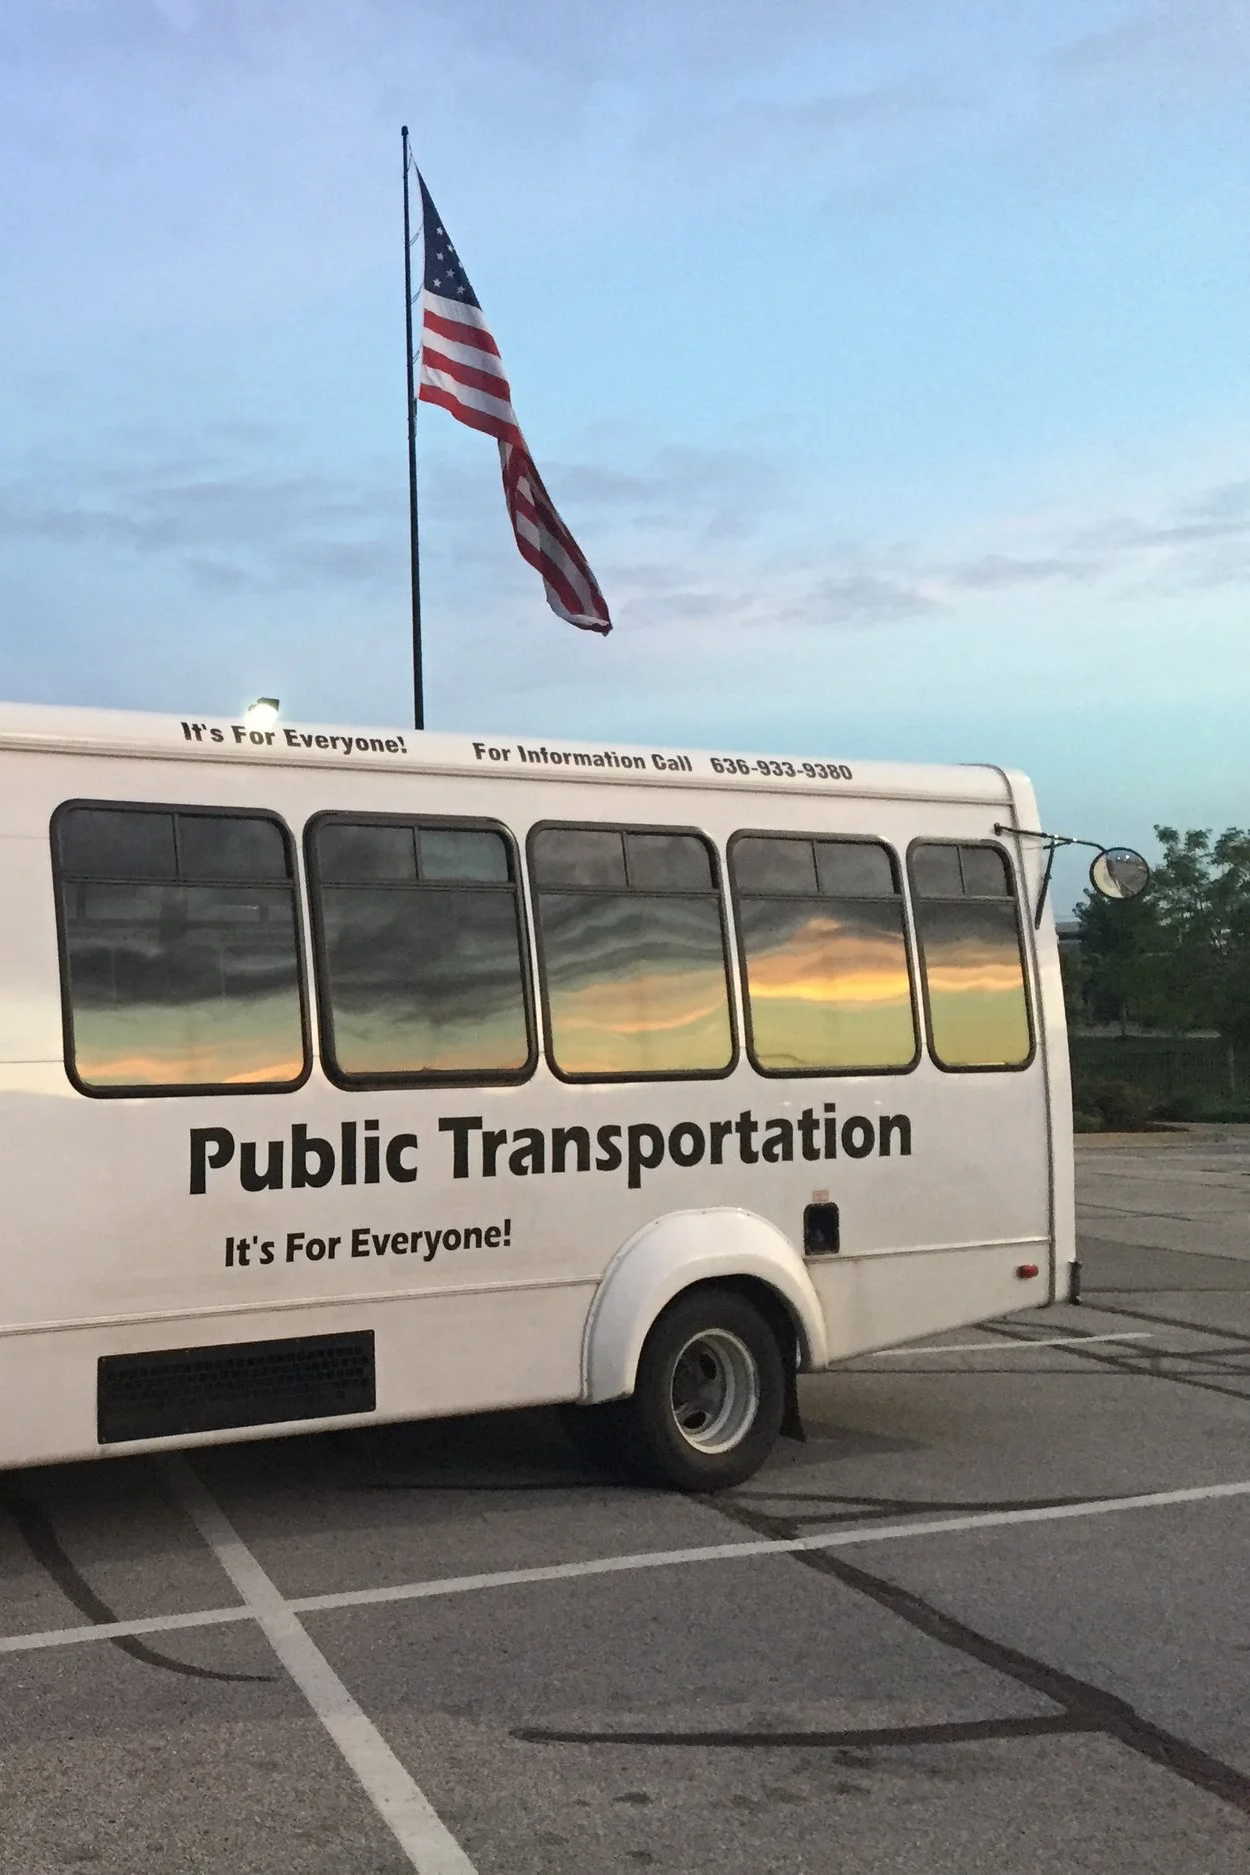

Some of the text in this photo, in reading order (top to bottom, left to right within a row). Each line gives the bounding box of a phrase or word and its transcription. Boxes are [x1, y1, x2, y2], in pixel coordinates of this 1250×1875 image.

[180, 721, 408, 755] It's For Everyone!
[472, 742, 853, 780] For Information Call 636-933-9380
[188, 1102, 913, 1195] Public Transportation
[224, 1218, 512, 1267] It's For Everyone!
